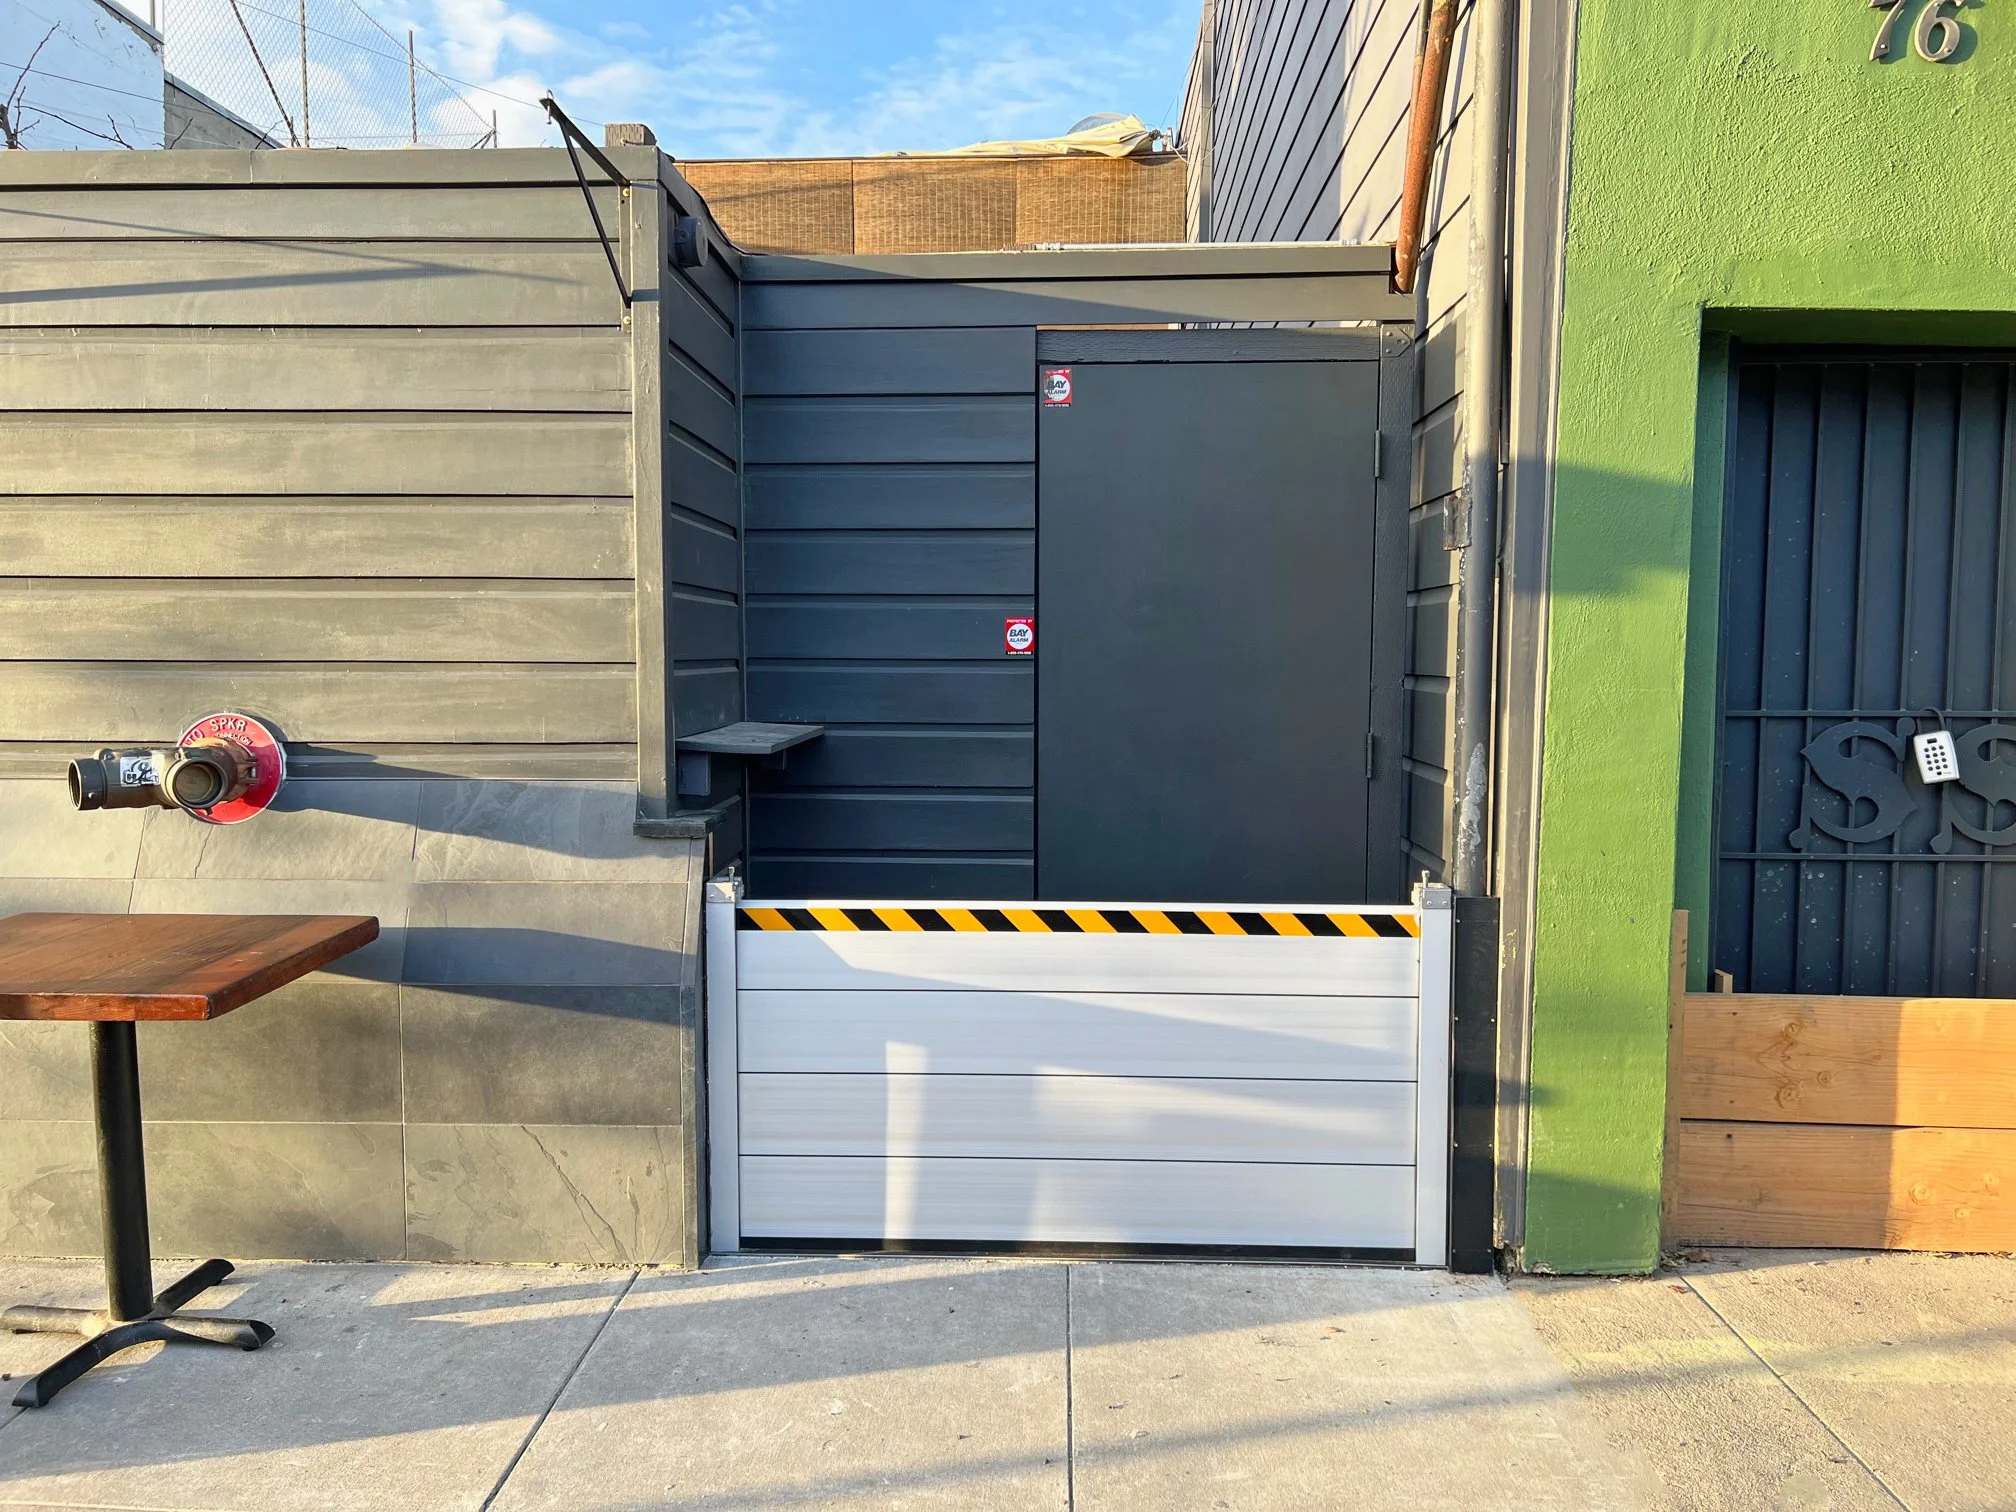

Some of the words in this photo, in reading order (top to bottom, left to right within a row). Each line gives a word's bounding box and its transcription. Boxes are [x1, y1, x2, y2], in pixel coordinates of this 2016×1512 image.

[1867, 0, 1964, 62] 76
[1009, 628, 1029, 637] BAY
[209, 717, 247, 732] SPKR
